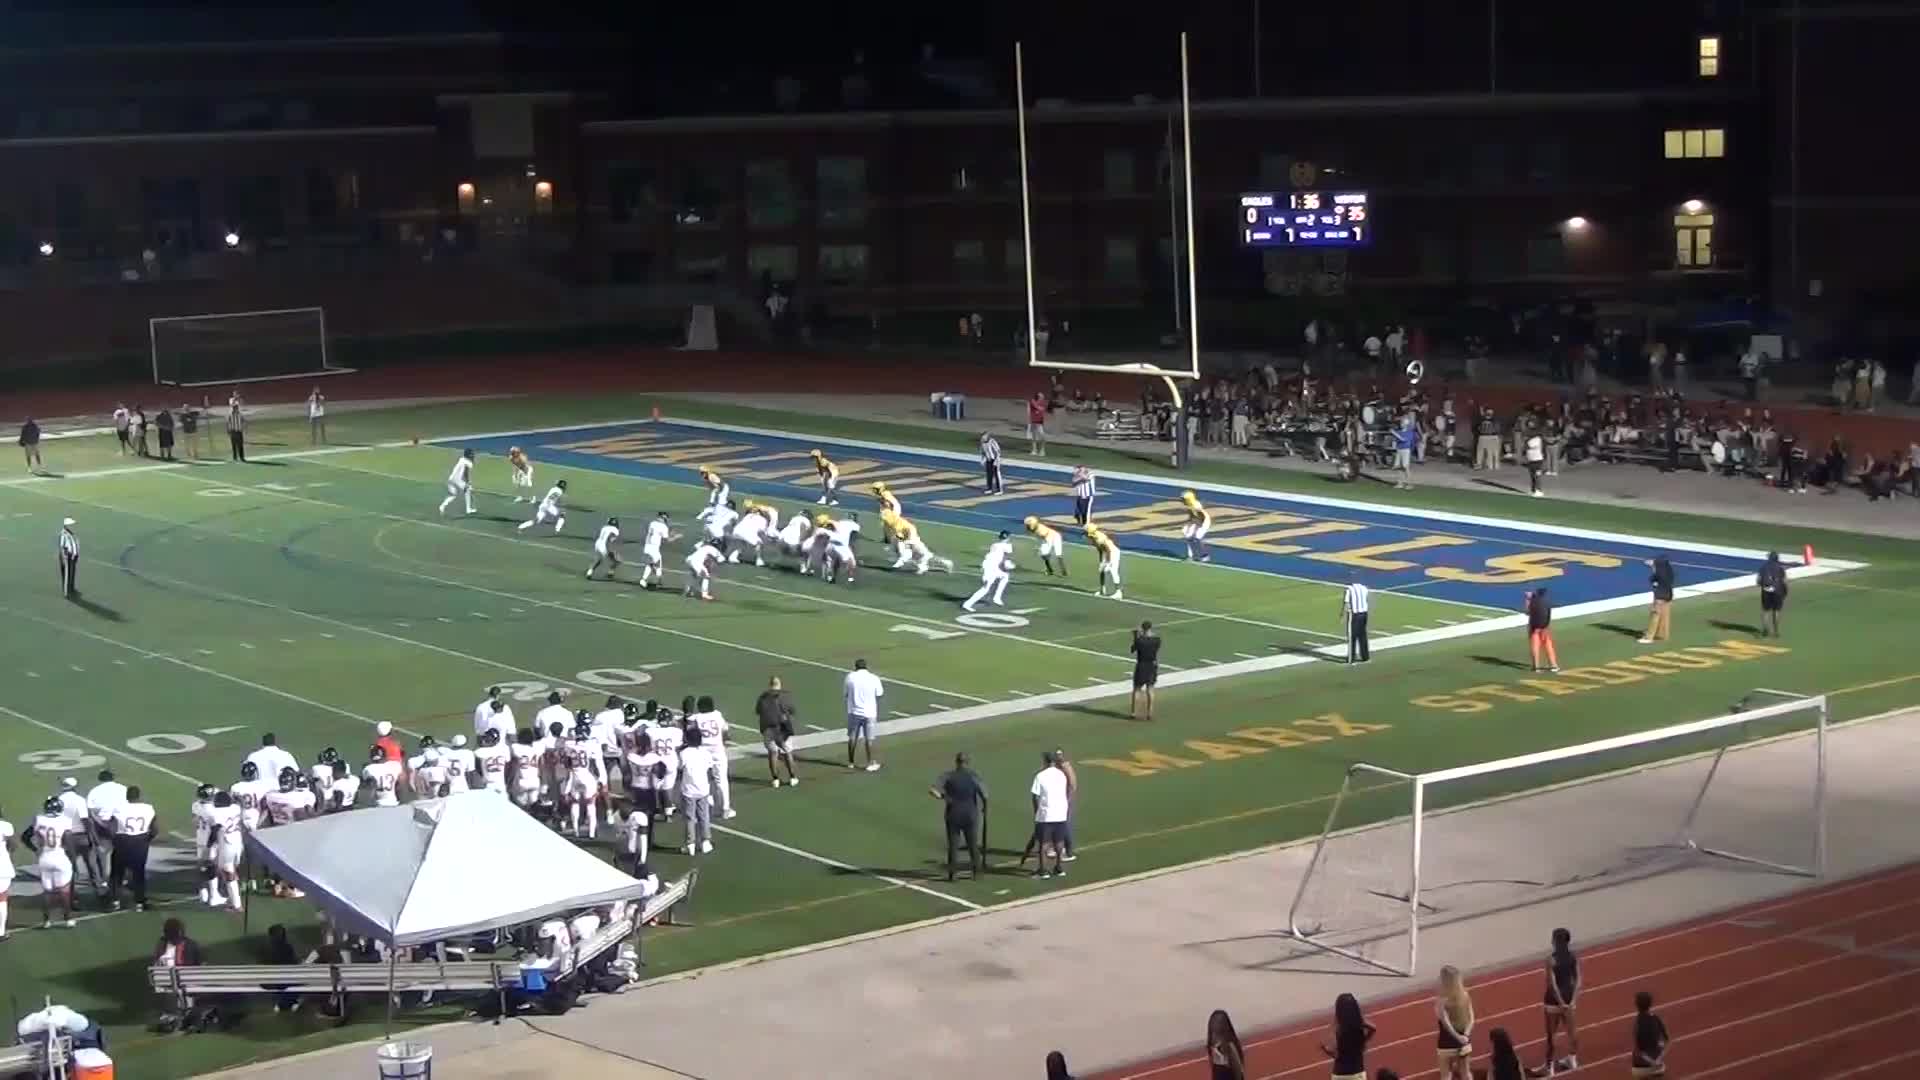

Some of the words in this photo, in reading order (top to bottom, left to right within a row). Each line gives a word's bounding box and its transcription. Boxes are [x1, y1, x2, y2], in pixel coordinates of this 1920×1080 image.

[1247, 207, 1257, 223] 0
[1347, 206, 1366, 221] 35
[1079, 711, 1393, 777] MARX
[1410, 639, 1793, 714] STADIUM
